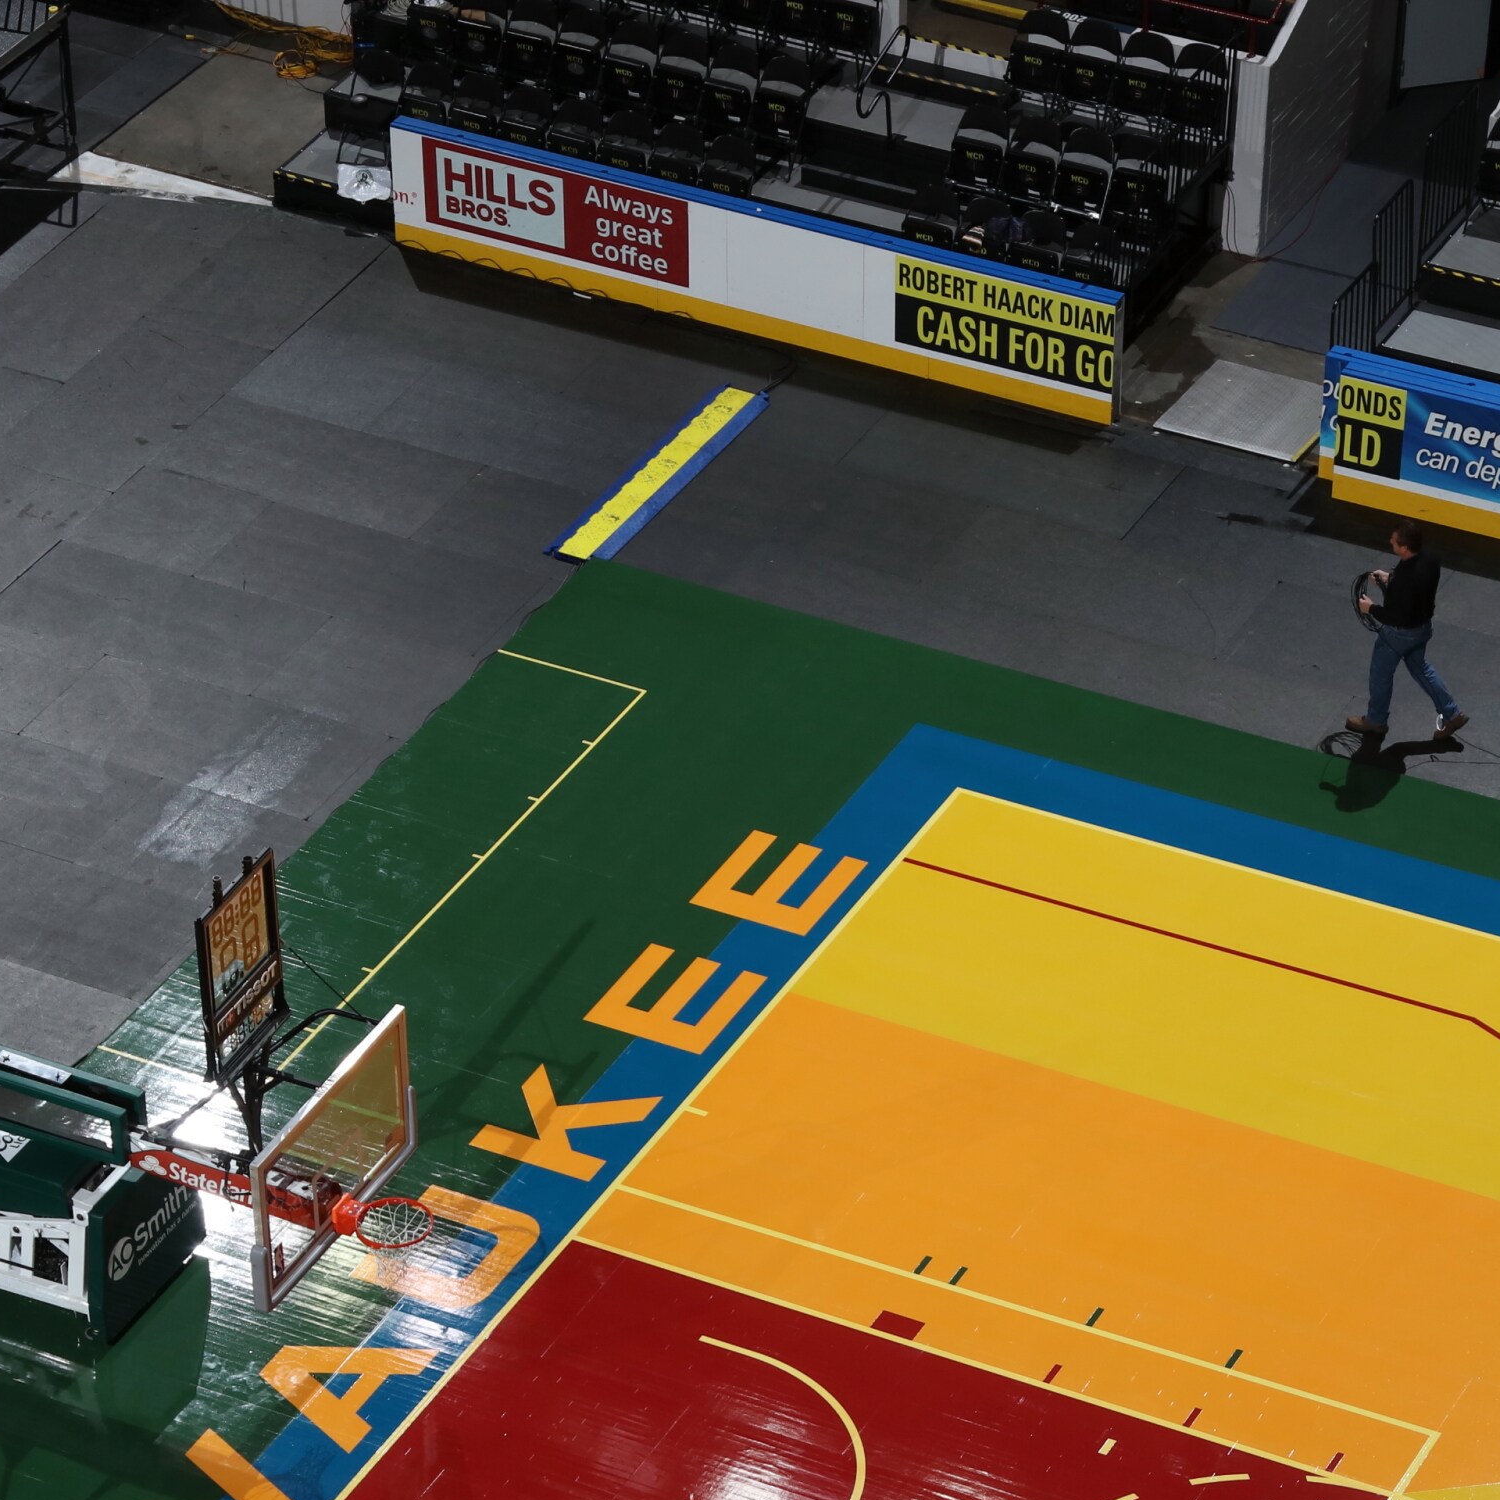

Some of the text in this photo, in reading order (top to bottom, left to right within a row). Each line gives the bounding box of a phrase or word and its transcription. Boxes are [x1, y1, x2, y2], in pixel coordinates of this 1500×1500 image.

[444, 158, 556, 216] HILLS
[584, 185, 673, 225] Always
[446, 195, 511, 227] BROS.
[596, 217, 663, 248] great
[591, 241, 668, 275] coffee
[899, 263, 1115, 338] ROBERT HAACK DIAM
[917, 305, 1114, 388] CASH FOR GO
[1341, 384, 1402, 421] ONDS
[1415, 448, 1460, 474] can
[211, 873, 262, 949] 88:88
[233, 960, 278, 1016] TISSOT
